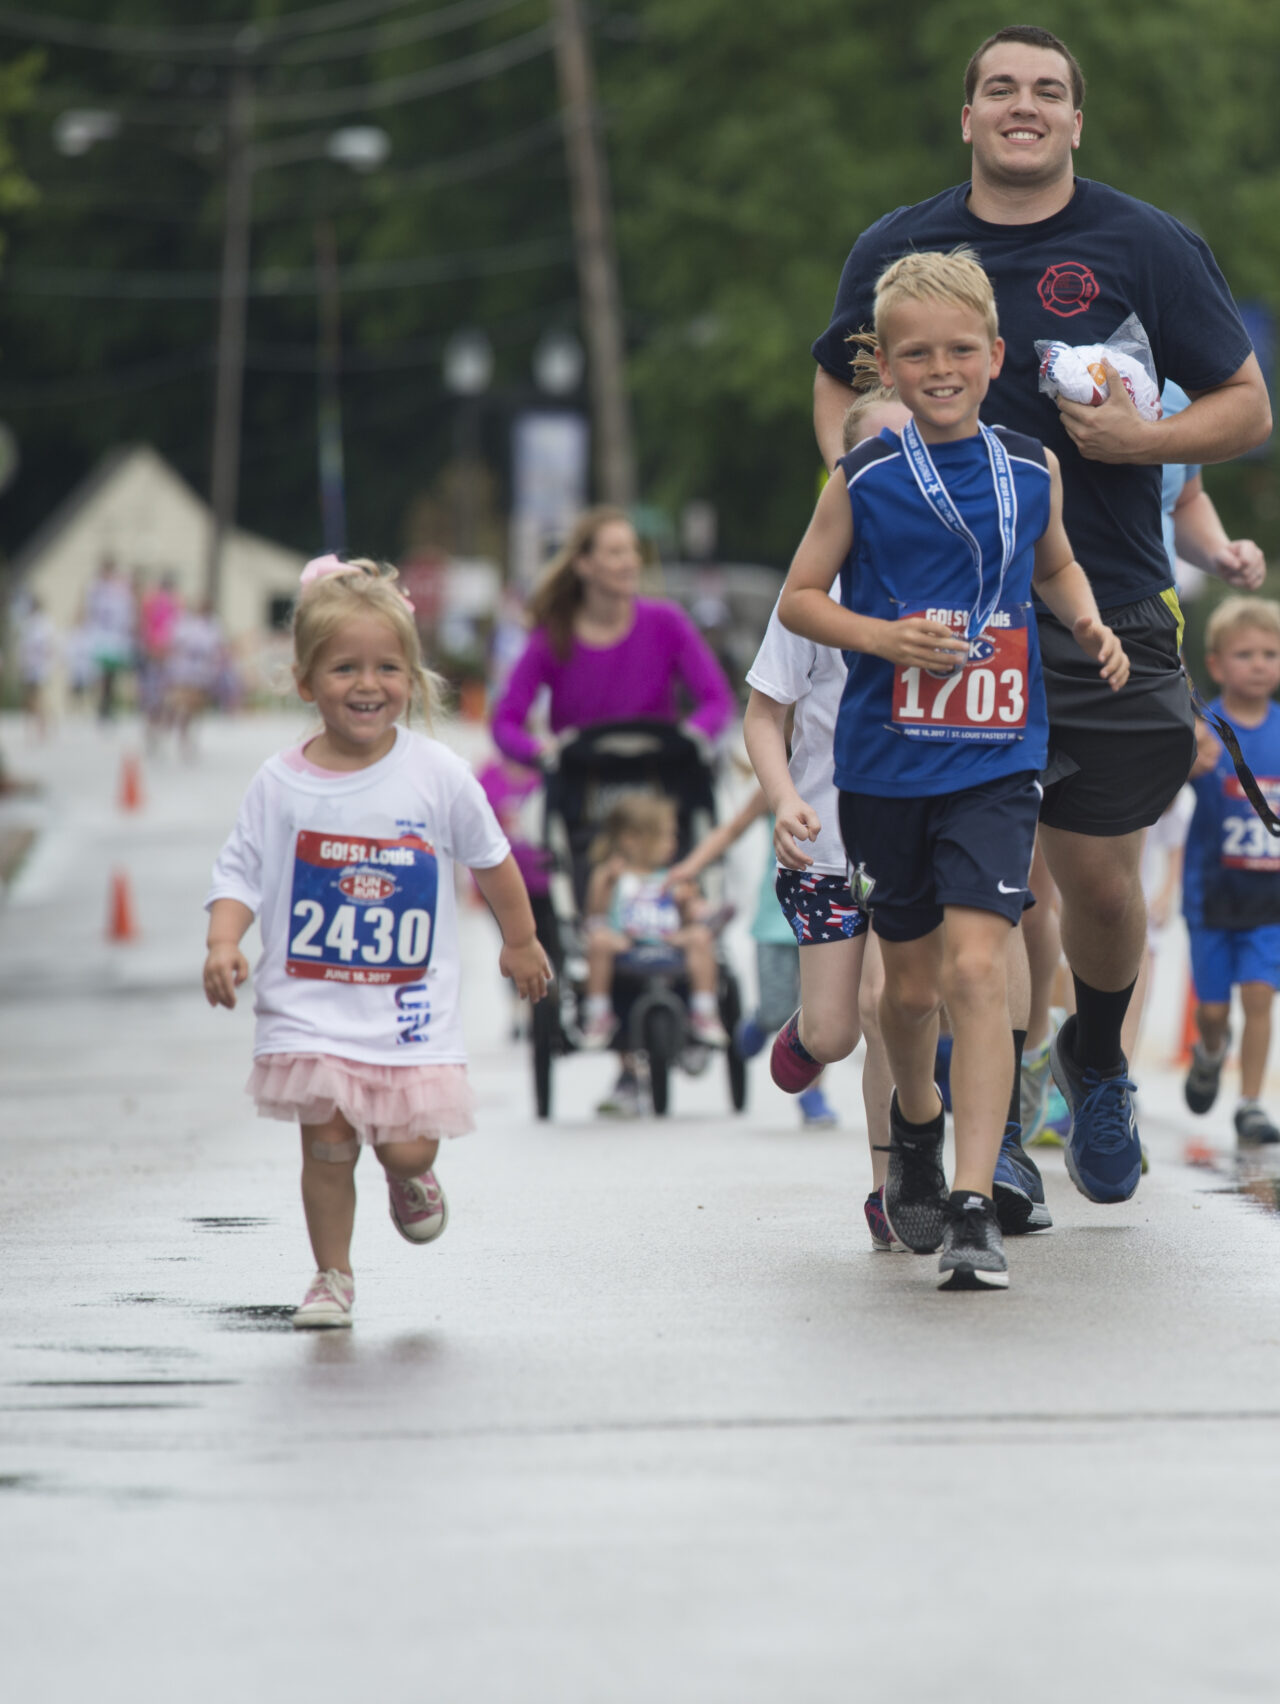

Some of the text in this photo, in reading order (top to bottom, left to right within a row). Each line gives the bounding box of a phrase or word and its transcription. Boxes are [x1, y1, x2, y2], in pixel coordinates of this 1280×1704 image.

[899, 667, 1025, 723] 1703
[904, 728, 921, 736] JUNE
[370, 846, 415, 866] Louis
[354, 875, 381, 888] FUN
[353, 886, 380, 899] RUN
[291, 899, 431, 964] 2430
[324, 968, 350, 980] JUNE
[368, 971, 391, 984] 2017
